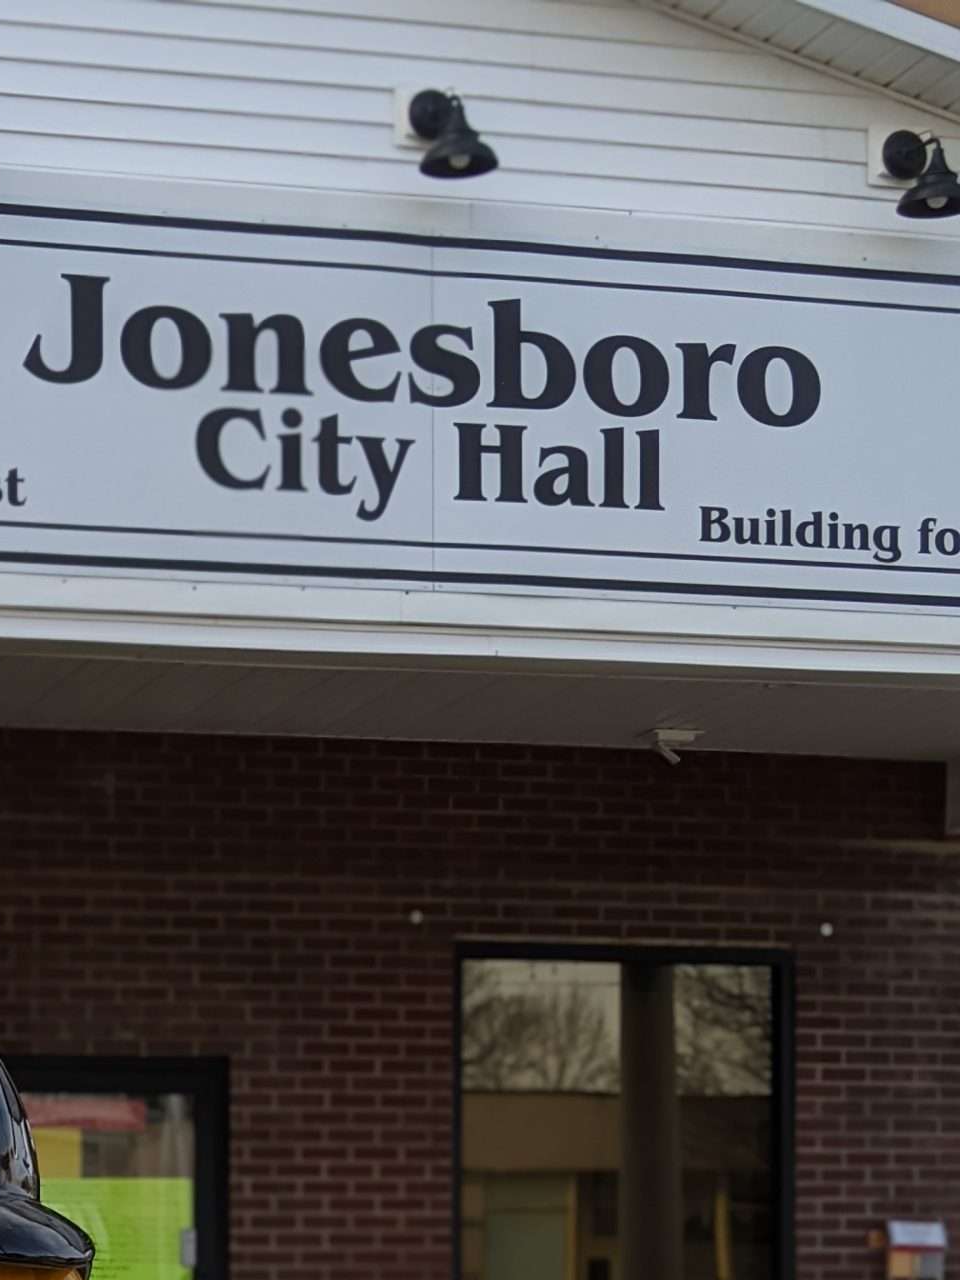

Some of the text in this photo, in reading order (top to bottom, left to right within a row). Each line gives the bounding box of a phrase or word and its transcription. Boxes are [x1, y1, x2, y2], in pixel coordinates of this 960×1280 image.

[23, 273, 820, 428] Jonesboro
[195, 407, 665, 522] City Hall
[699, 505, 902, 564] Building
